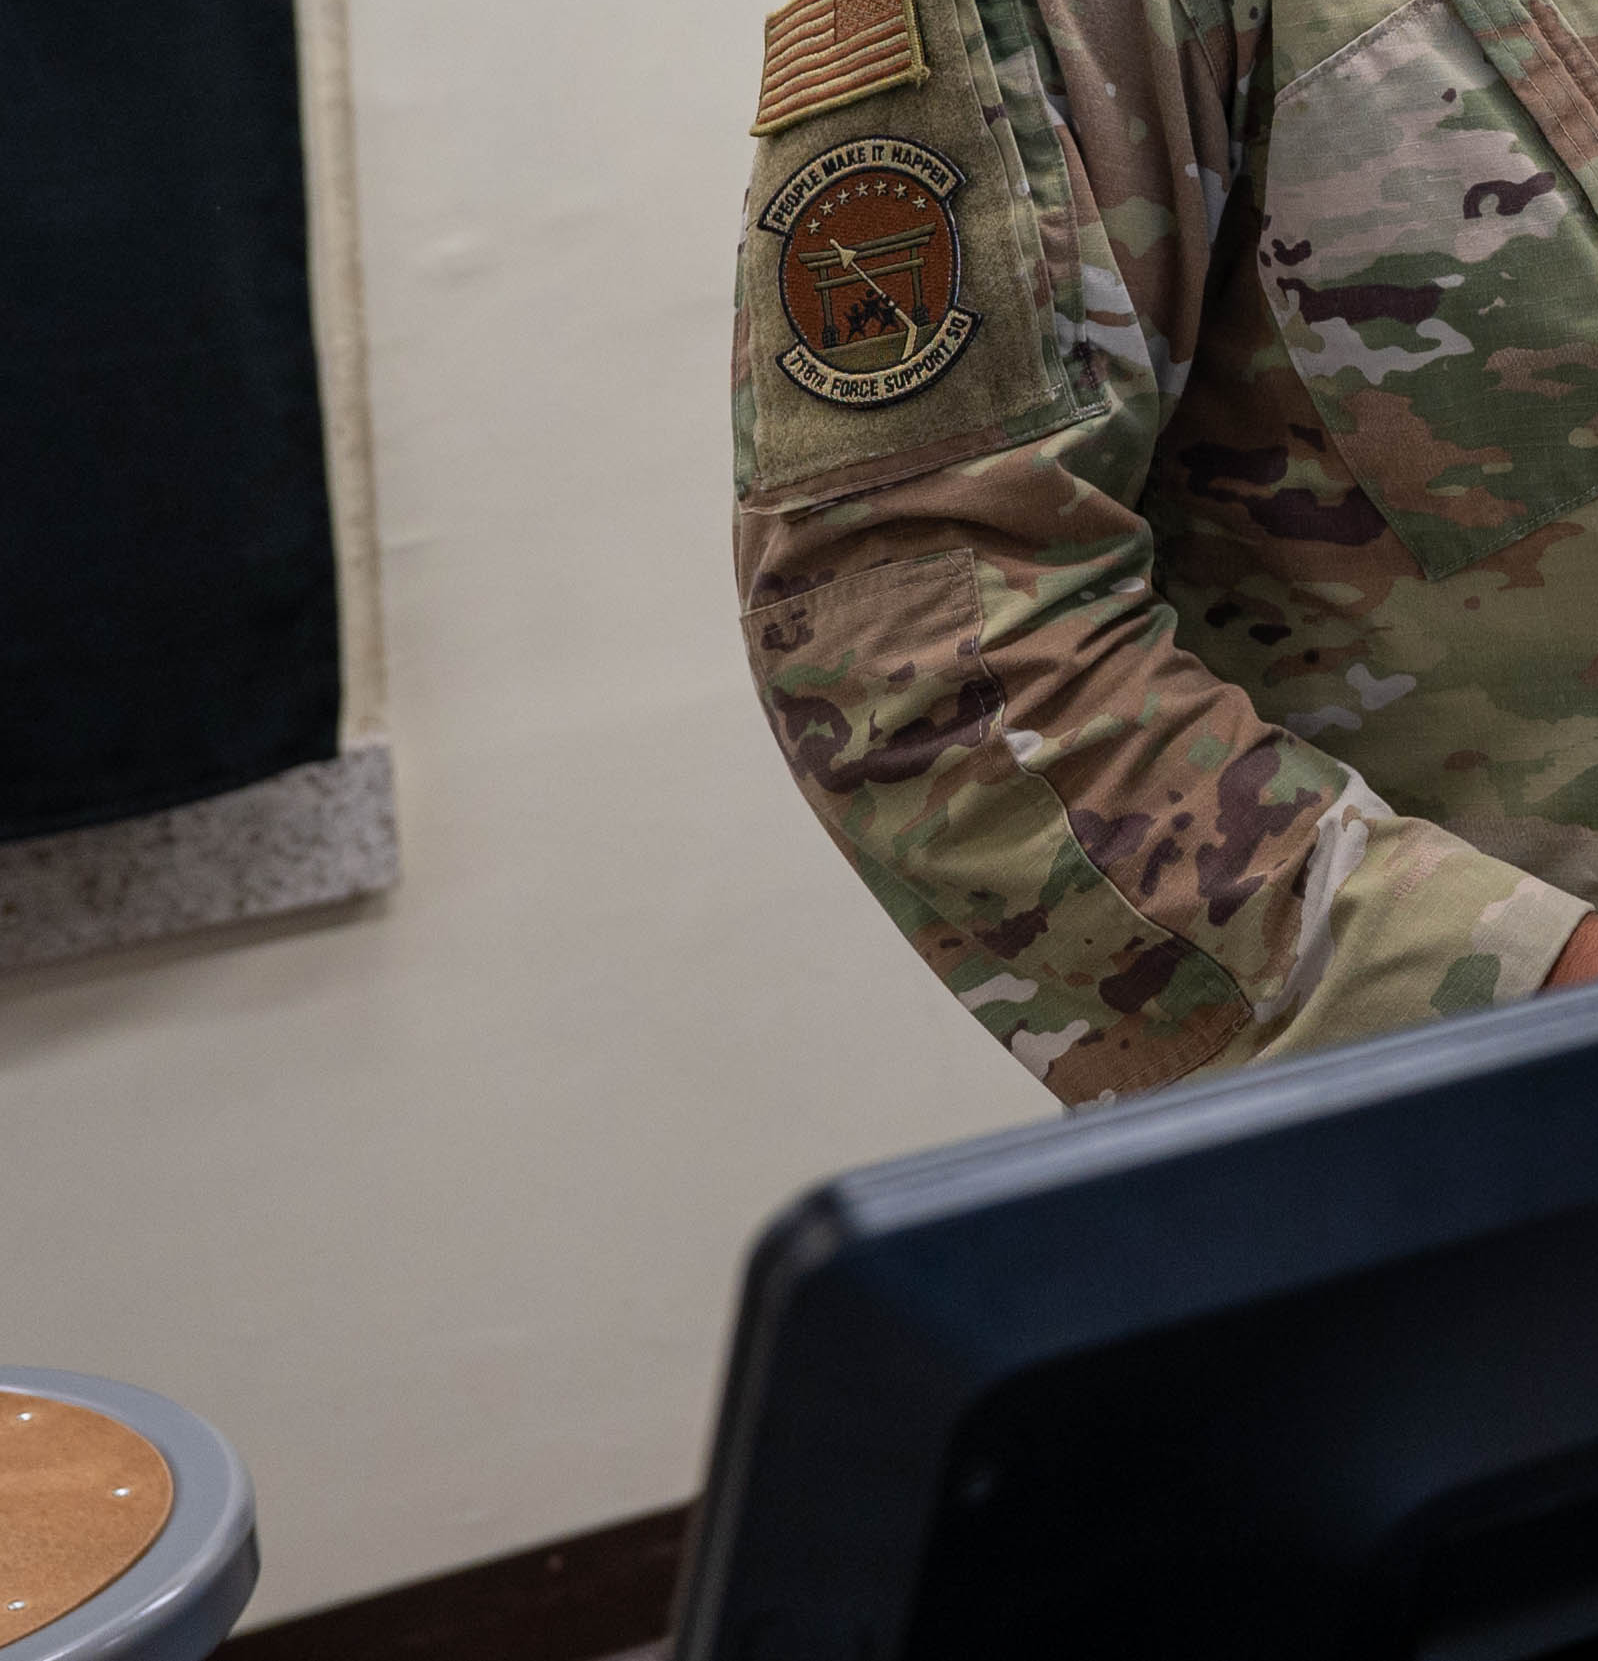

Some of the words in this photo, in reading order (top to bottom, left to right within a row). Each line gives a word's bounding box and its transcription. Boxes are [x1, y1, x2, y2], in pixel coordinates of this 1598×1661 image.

[772, 170, 821, 227] PEOPLE
[822, 144, 867, 178] MAKE
[871, 144, 885, 161] IT
[891, 144, 950, 188] HAPPEN
[789, 351, 828, 390] 718TH
[831, 380, 879, 397] FORCE
[884, 344, 952, 390] SUPPORT
[947, 316, 966, 339] SQ
